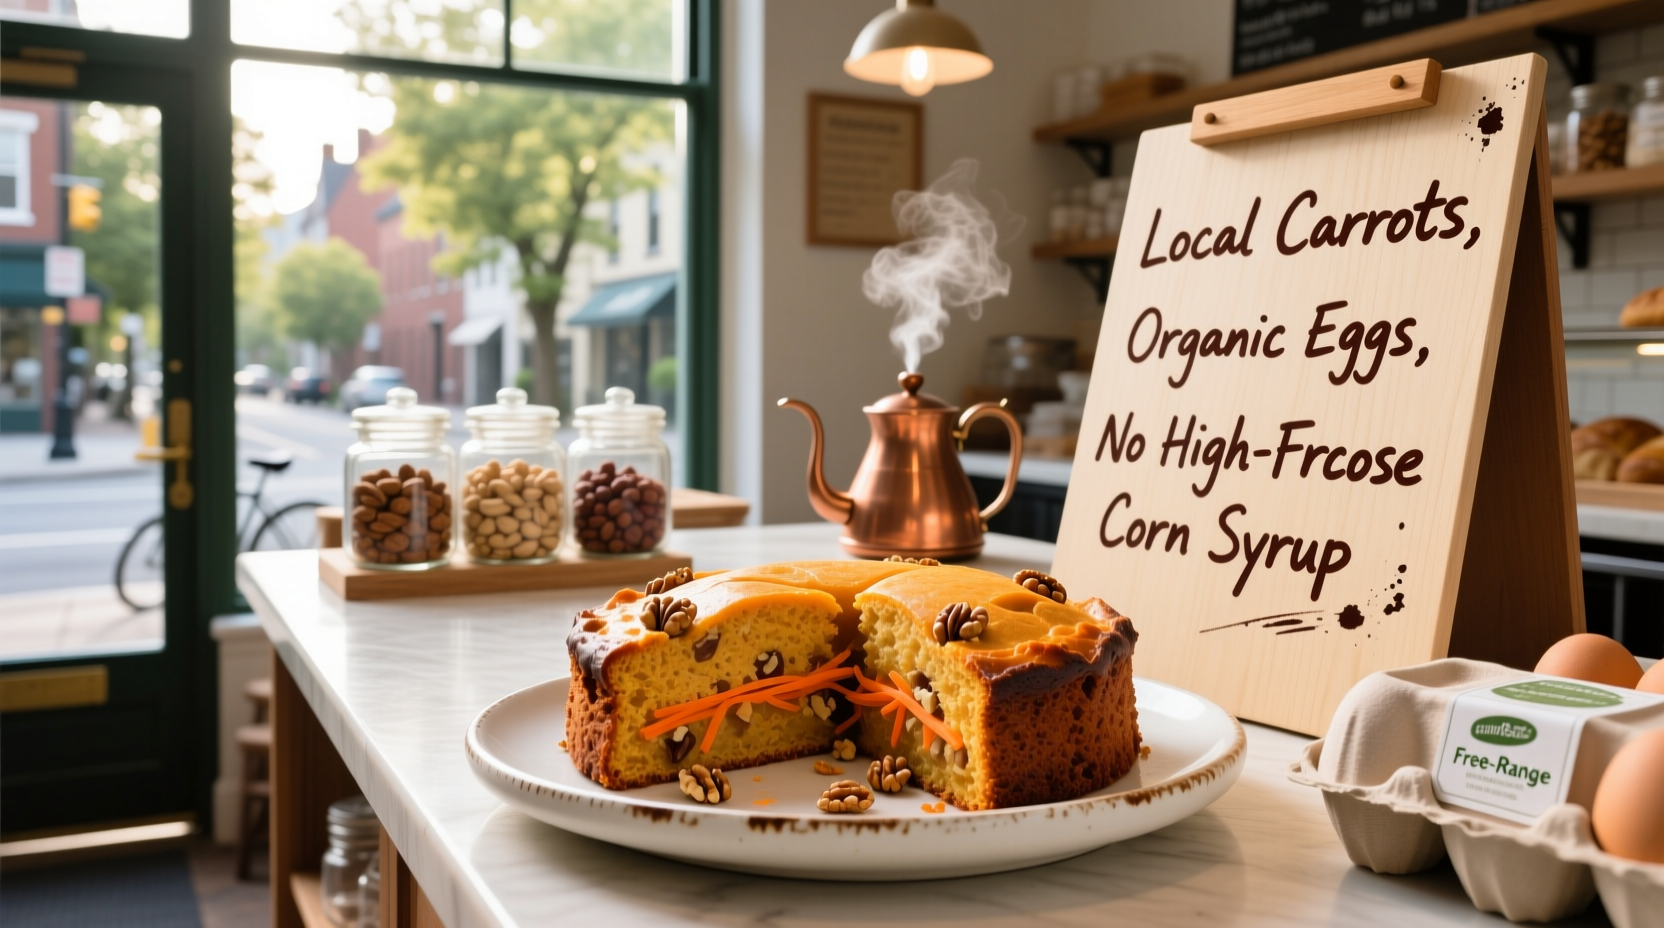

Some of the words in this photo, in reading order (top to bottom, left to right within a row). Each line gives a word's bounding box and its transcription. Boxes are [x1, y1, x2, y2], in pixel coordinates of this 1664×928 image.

[1140, 197, 1261, 268] Local
[1277, 180, 1480, 256] Carrots,
[1128, 307, 1285, 388] Organic
[1305, 300, 1429, 386] Eggs,
[1095, 412, 1146, 463] No
[1160, 415, 1424, 498] High-Frcose
[1100, 492, 1190, 555] Corn
[1208, 504, 1352, 602] Syrup
[1453, 747, 1551, 787] Free-Range
